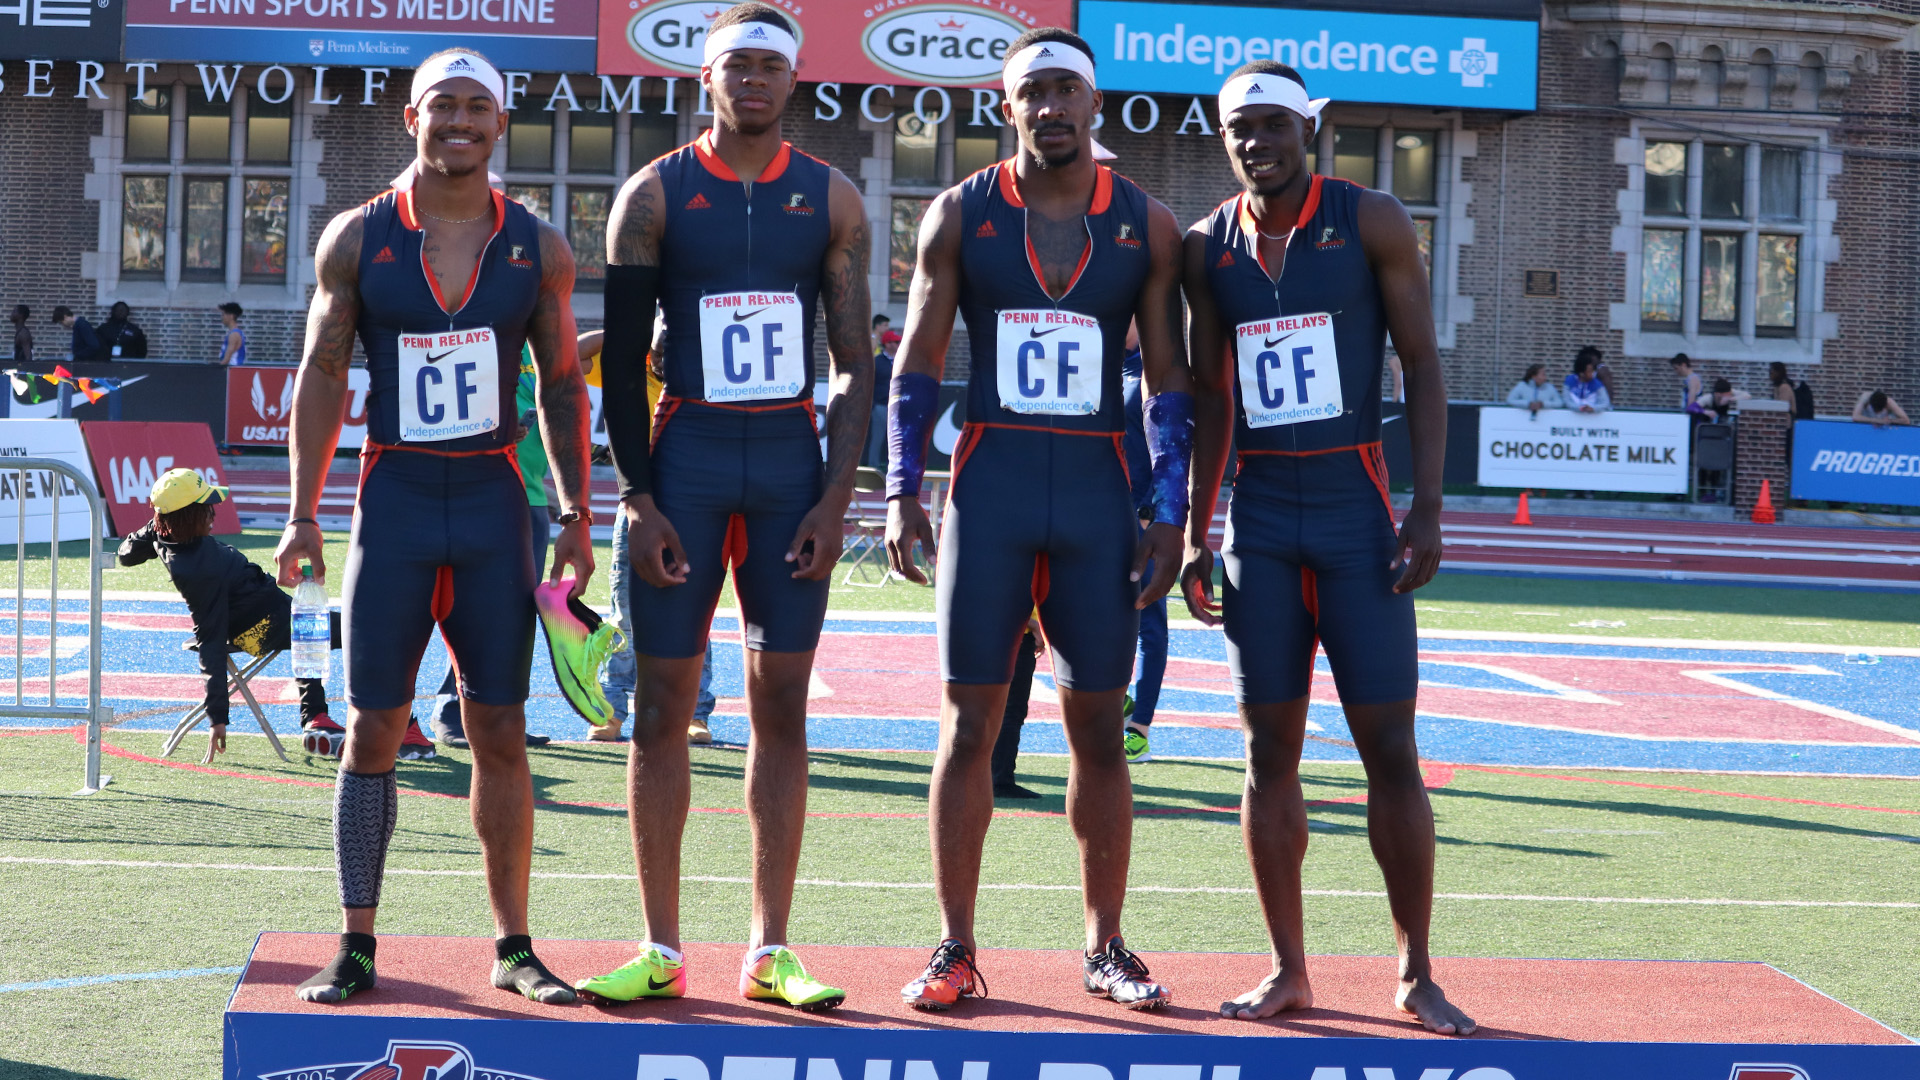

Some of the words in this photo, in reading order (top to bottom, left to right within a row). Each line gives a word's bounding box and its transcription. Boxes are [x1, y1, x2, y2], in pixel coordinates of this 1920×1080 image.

[397, 0, 555, 24] MEDICINE
[327, 40, 354, 53] Penn
[358, 41, 410, 54] Medicine
[886, 28, 1009, 60] Grace
[1114, 22, 1438, 75] Independence
[444, 65, 476, 73] adidas
[0, 59, 157, 101] ERT
[195, 63, 390, 106] WOLF
[502, 71, 715, 116] FAMIL
[705, 296, 742, 309] PENN
[748, 294, 795, 306] RELAYS
[1004, 312, 1039, 324] PENN
[1045, 313, 1094, 329] RELAYS
[1239, 322, 1271, 338] PENN
[1276, 315, 1327, 332] RELAYS
[403, 336, 433, 349] PENN
[439, 330, 490, 347] RELAYS
[722, 322, 784, 385] CF
[1017, 340, 1080, 399] CF
[1255, 345, 1316, 410] CF
[416, 361, 478, 426] CF
[711, 384, 787, 398] Independence
[1251, 406, 1323, 424] Independence
[242, 425, 290, 441] USAT
[406, 421, 480, 438] Independence
[1550, 427, 1584, 437] BUILT
[1587, 428, 1620, 438] WITH
[1491, 441, 1620, 463] CHOCOLATE
[1627, 446, 1677, 465] MILK
